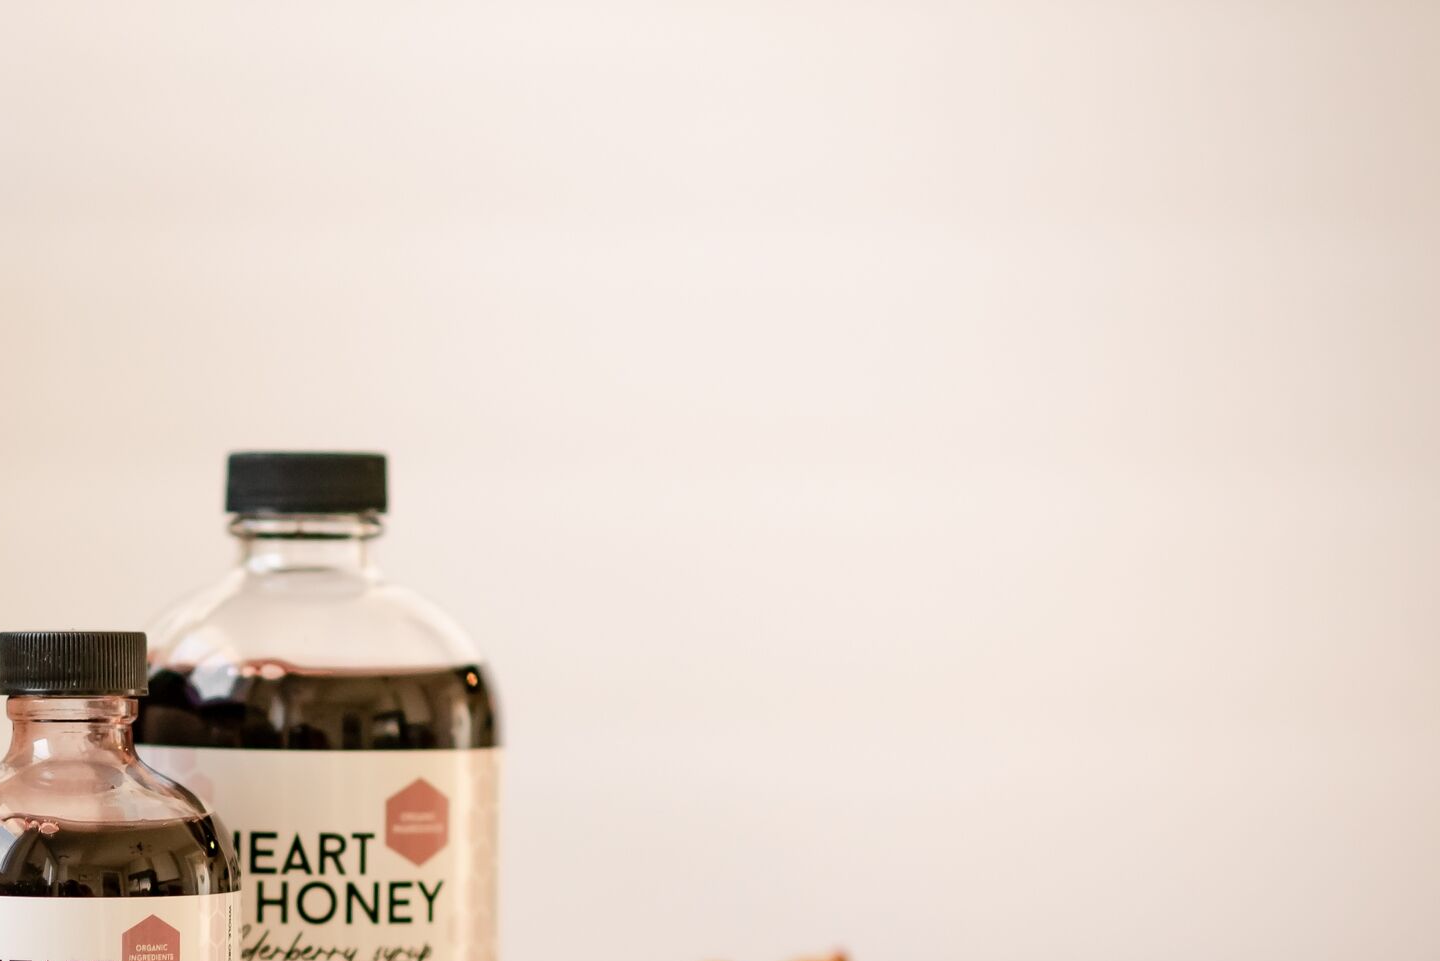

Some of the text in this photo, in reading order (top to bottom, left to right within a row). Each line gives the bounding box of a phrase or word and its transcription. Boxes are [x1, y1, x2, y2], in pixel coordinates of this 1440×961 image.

[255, 880, 443, 925] HONEY
[135, 943, 168, 952] ORGANIC
[128, 953, 174, 961] INGREDIENTS
